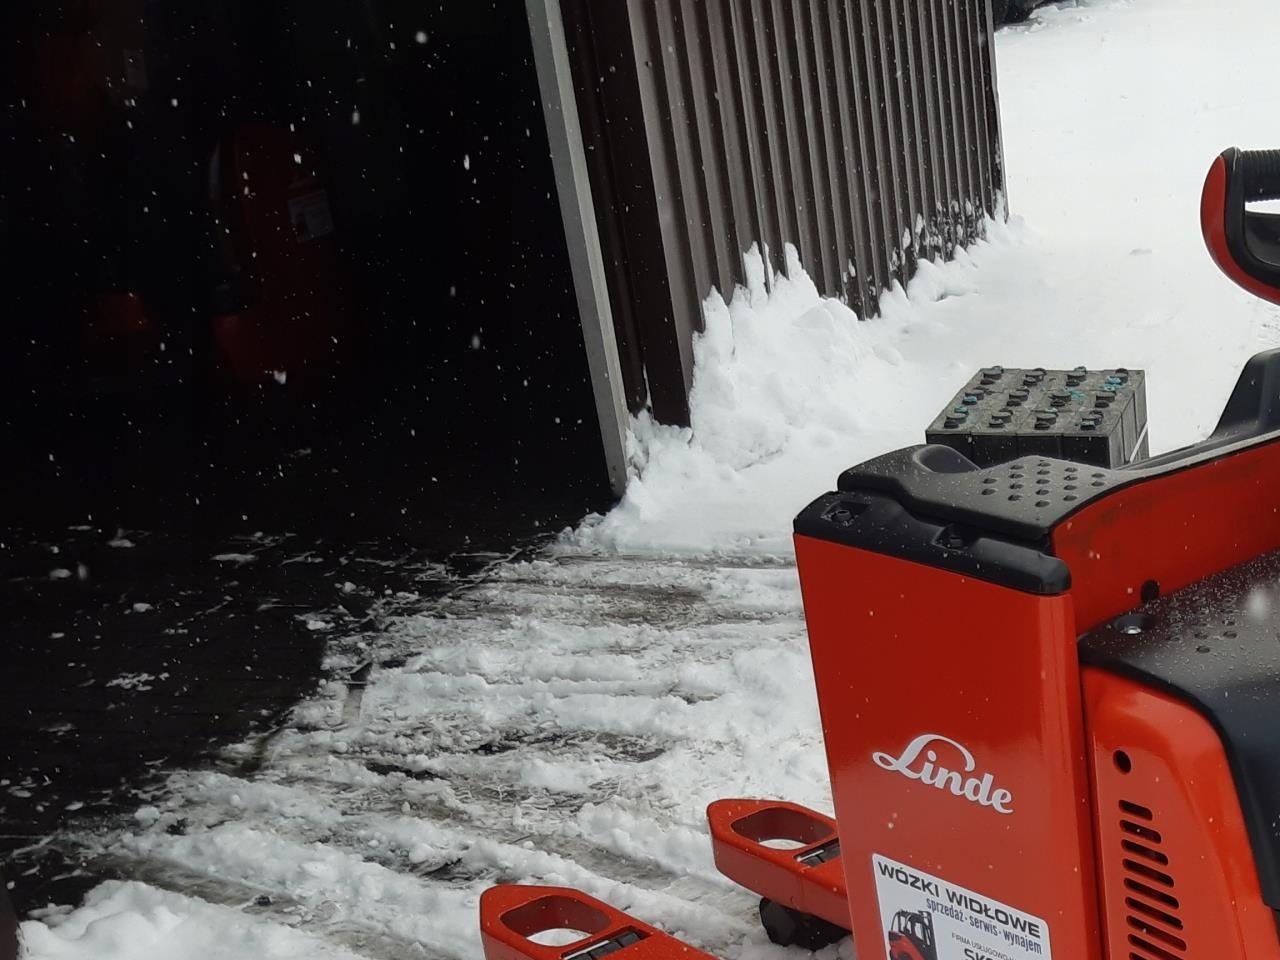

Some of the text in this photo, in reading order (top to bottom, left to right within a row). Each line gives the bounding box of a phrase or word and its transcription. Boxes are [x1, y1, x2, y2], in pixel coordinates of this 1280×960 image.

[872, 734, 1014, 814] Linde
[878, 861, 1041, 939] WÓZKI WIDŁOWE
[926, 898, 1043, 955] sprzedaż serwis wynajem
[951, 932, 971, 947] FIRMA
